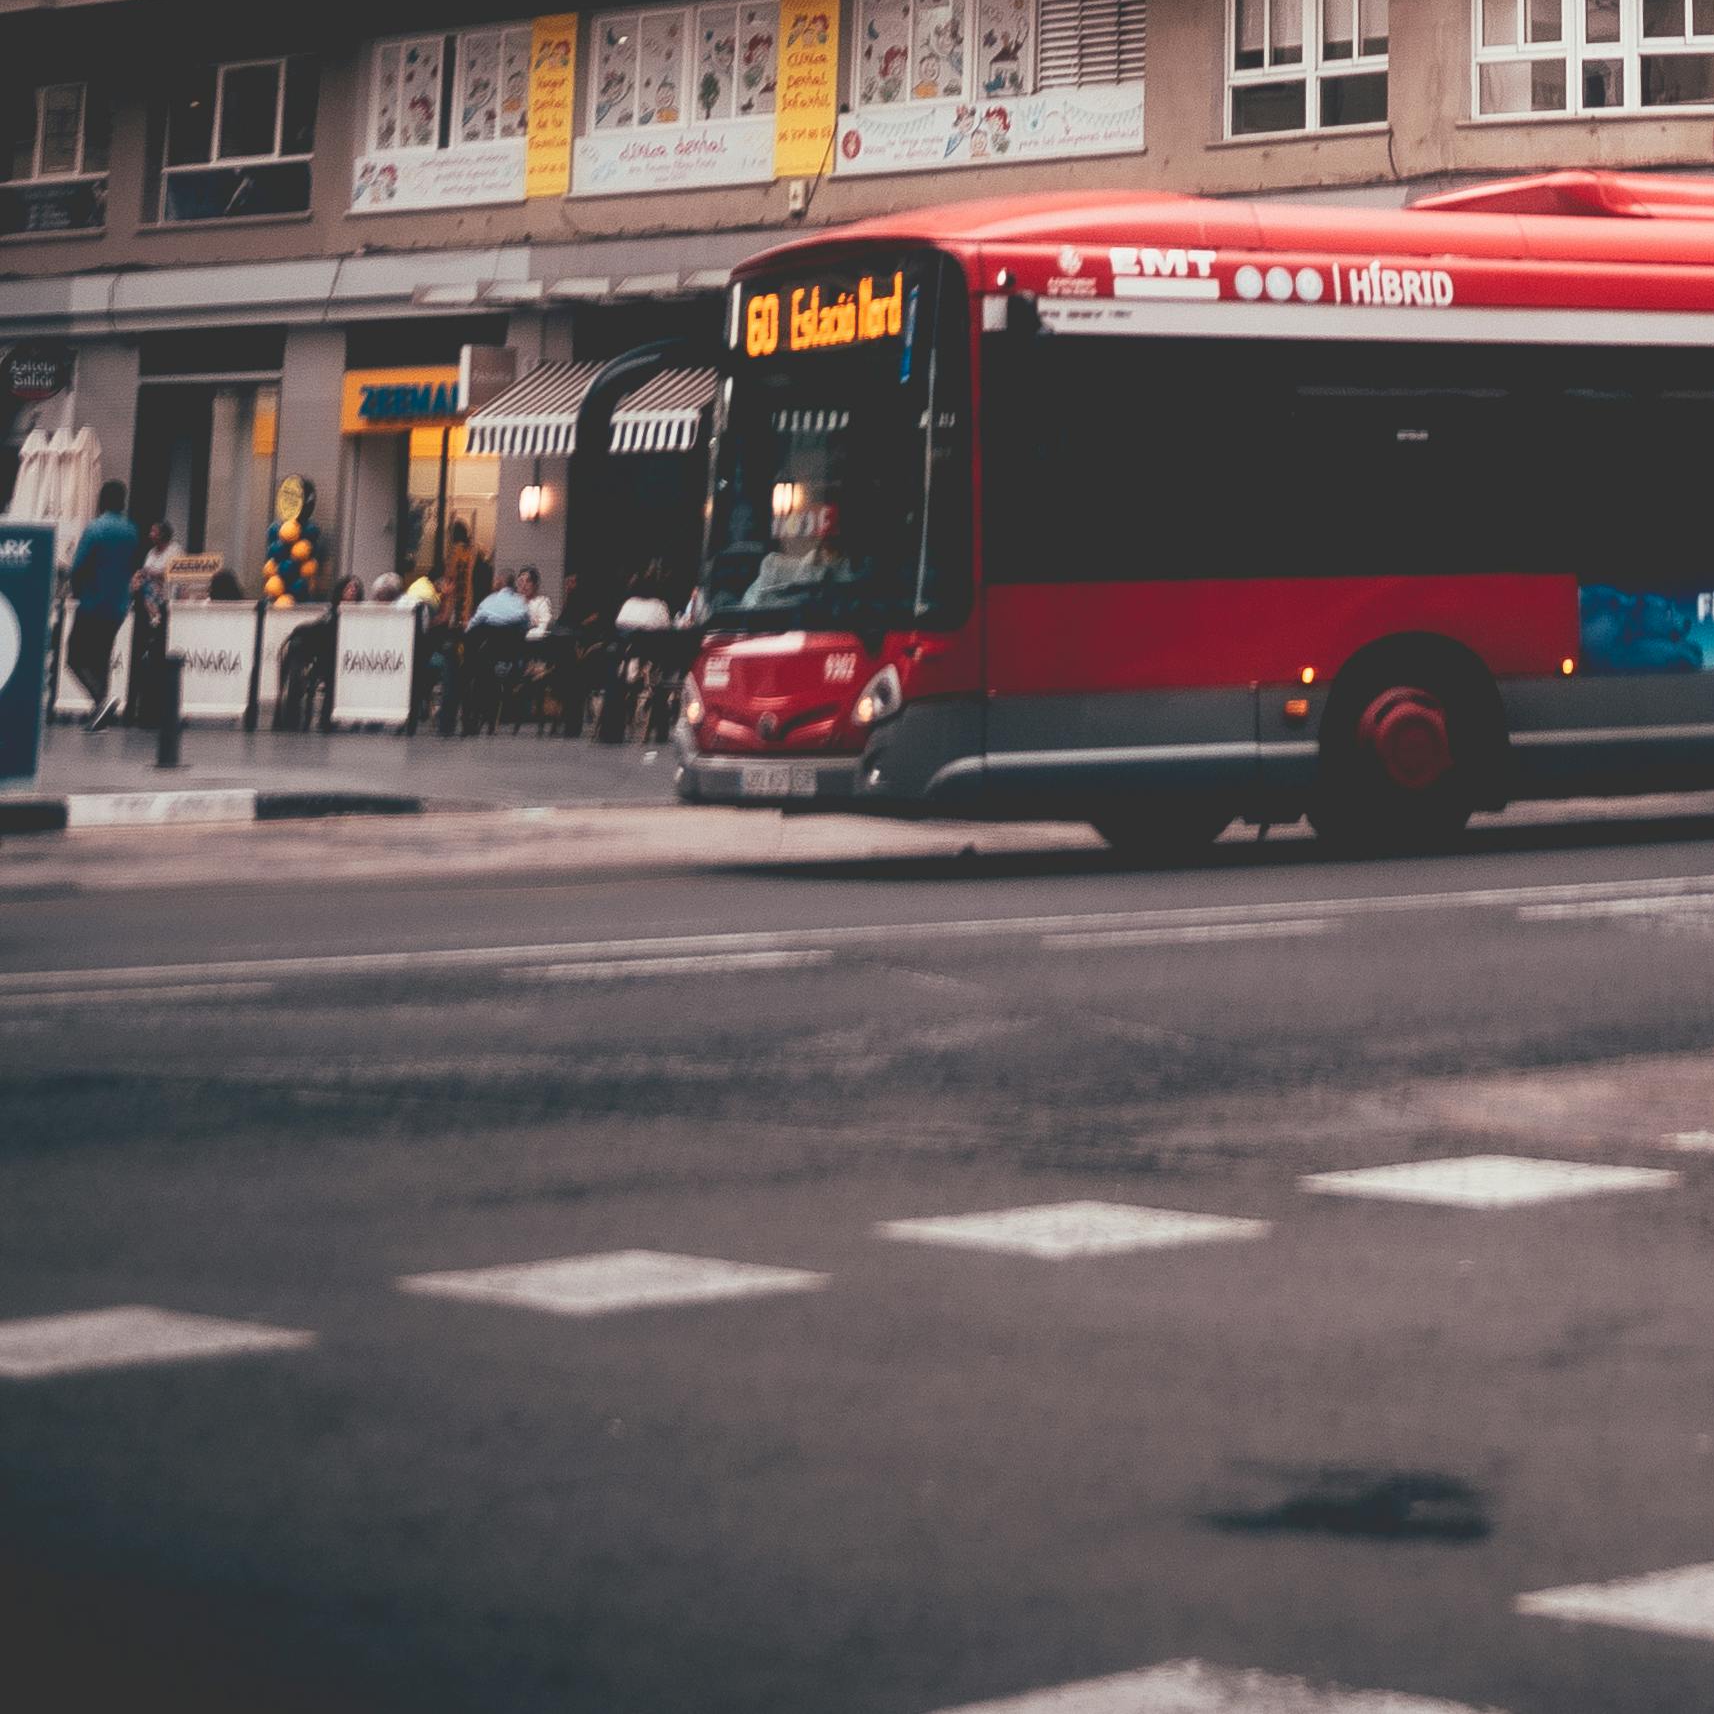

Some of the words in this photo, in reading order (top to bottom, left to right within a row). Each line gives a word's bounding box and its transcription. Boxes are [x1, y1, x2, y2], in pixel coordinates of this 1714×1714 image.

[1108, 246, 1218, 277] EMT
[1349, 260, 1455, 306] HÍBRID
[746, 293, 780, 358] 60
[182, 648, 244, 675] ANARIA
